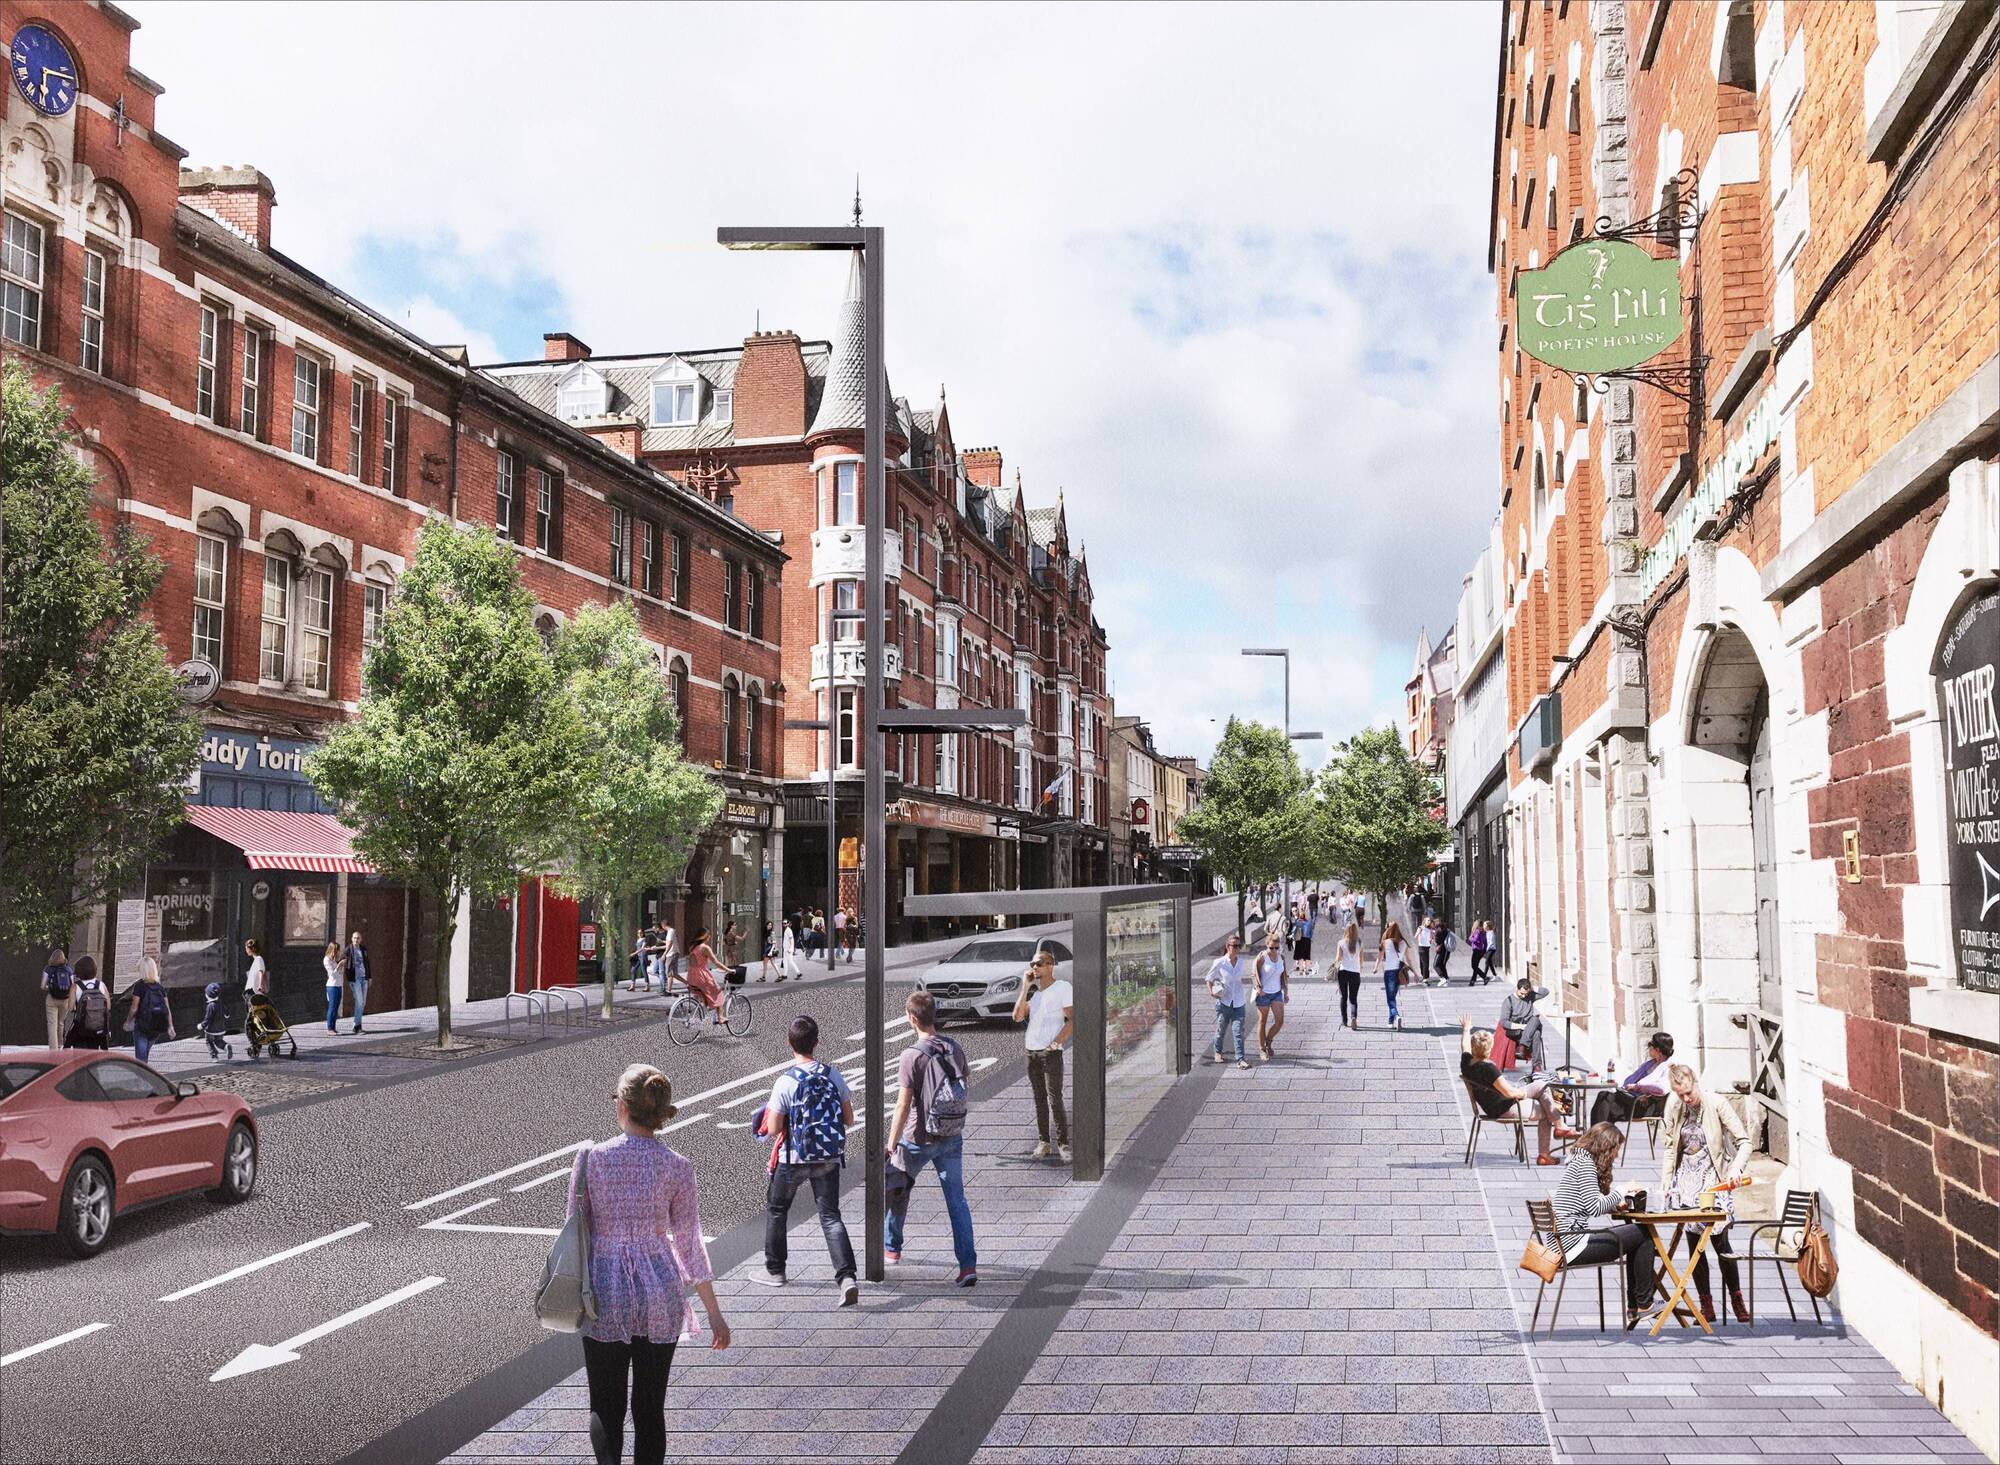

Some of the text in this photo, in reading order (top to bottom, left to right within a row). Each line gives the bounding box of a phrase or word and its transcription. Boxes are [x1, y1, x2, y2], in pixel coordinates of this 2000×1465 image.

[1538, 332, 1665, 352] POETS' HOUSE
[1943, 664, 2000, 770] MOTHER
[1980, 743, 2000, 765] FLEA
[1950, 764, 2000, 819] VINTAGE &
[1955, 821, 1977, 845] YORK
[153, 894, 213, 912] TORINO'S
